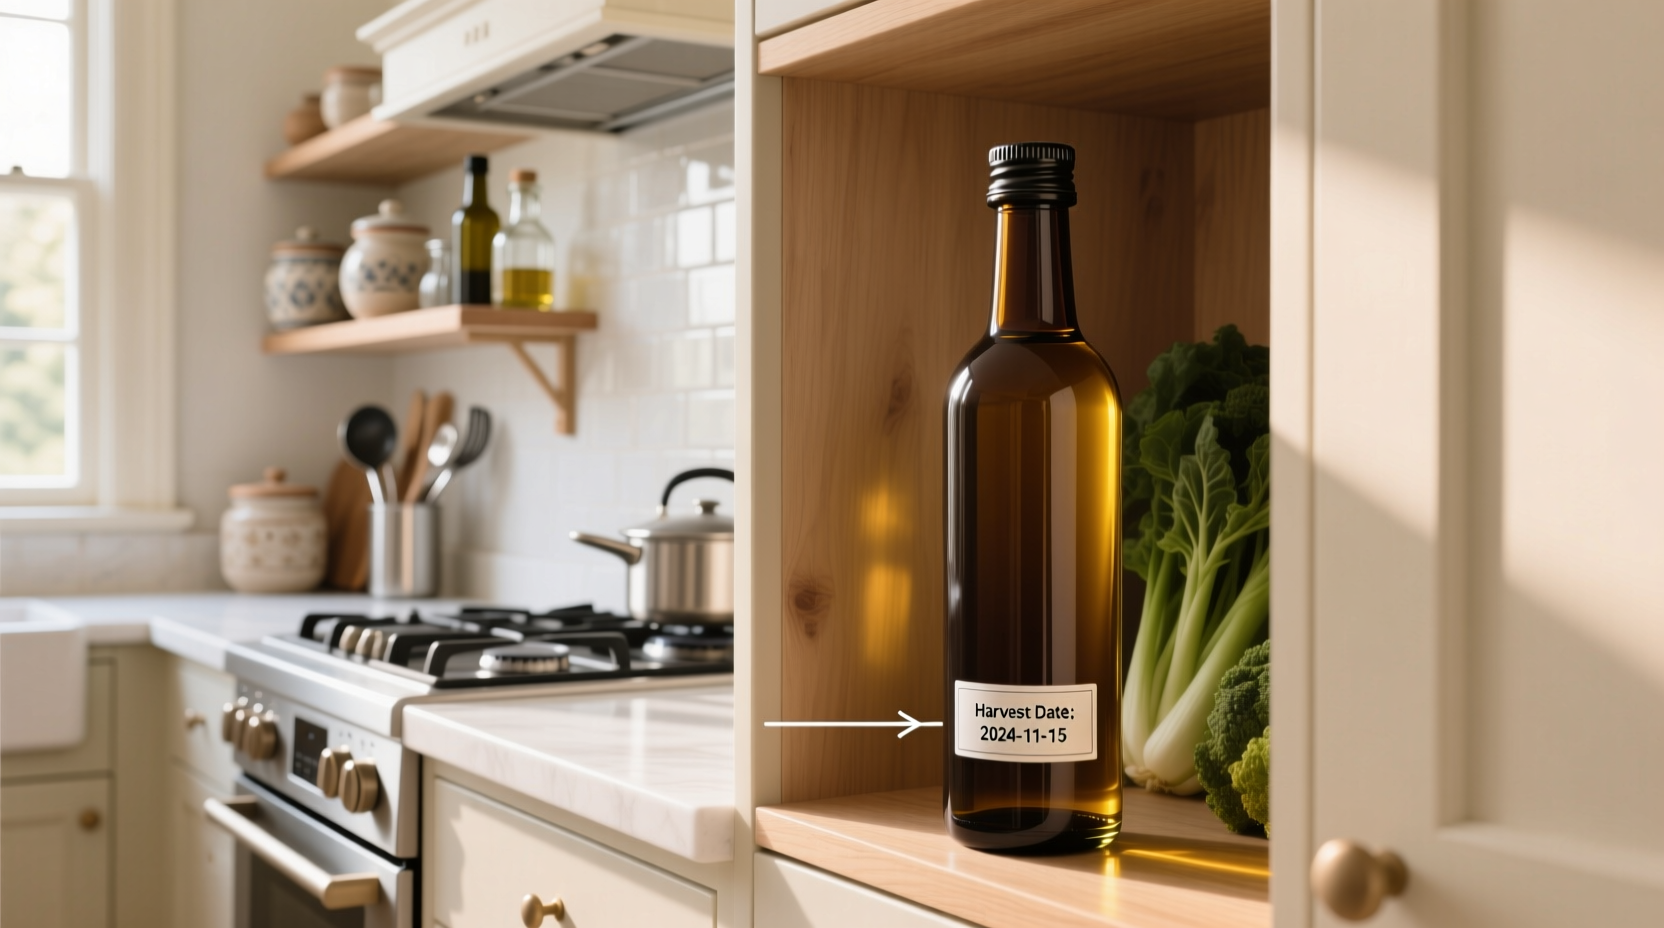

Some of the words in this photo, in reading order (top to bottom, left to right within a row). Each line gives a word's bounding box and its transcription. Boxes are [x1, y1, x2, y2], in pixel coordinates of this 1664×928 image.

[975, 702, 1032, 720] Harvest
[1035, 704, 1075, 720] Date:
[980, 725, 1067, 743] 2024-11-15
